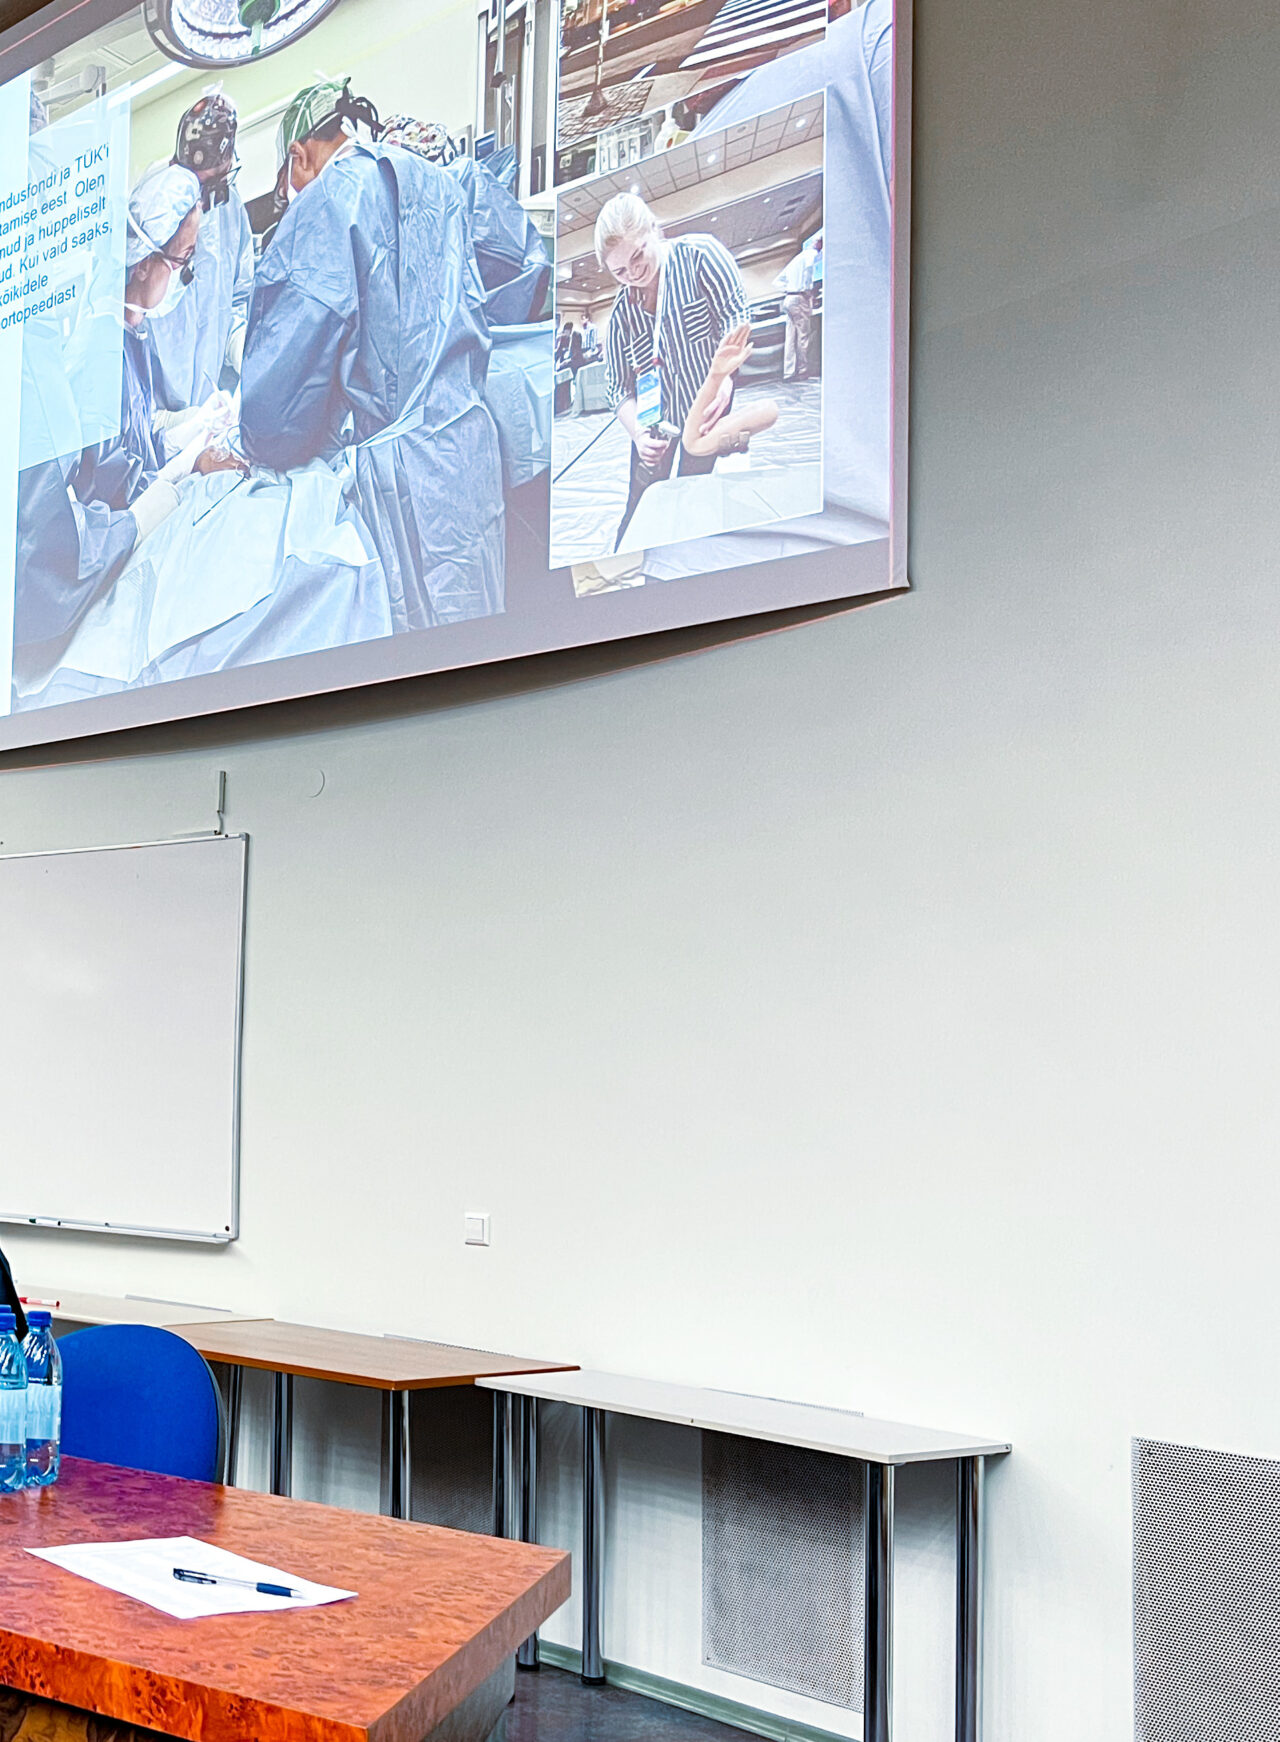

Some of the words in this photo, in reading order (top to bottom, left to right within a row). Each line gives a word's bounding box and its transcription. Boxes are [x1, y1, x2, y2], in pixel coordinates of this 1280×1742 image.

[41, 191, 67, 215] eest
[75, 174, 105, 197] Olen
[59, 166, 70, 187] ja
[20, 249, 39, 273] Kui
[43, 236, 67, 262] vaid
[71, 221, 112, 249] saaks,
[24, 232, 35, 253] ja
[39, 196, 106, 240] hüppeliselt
